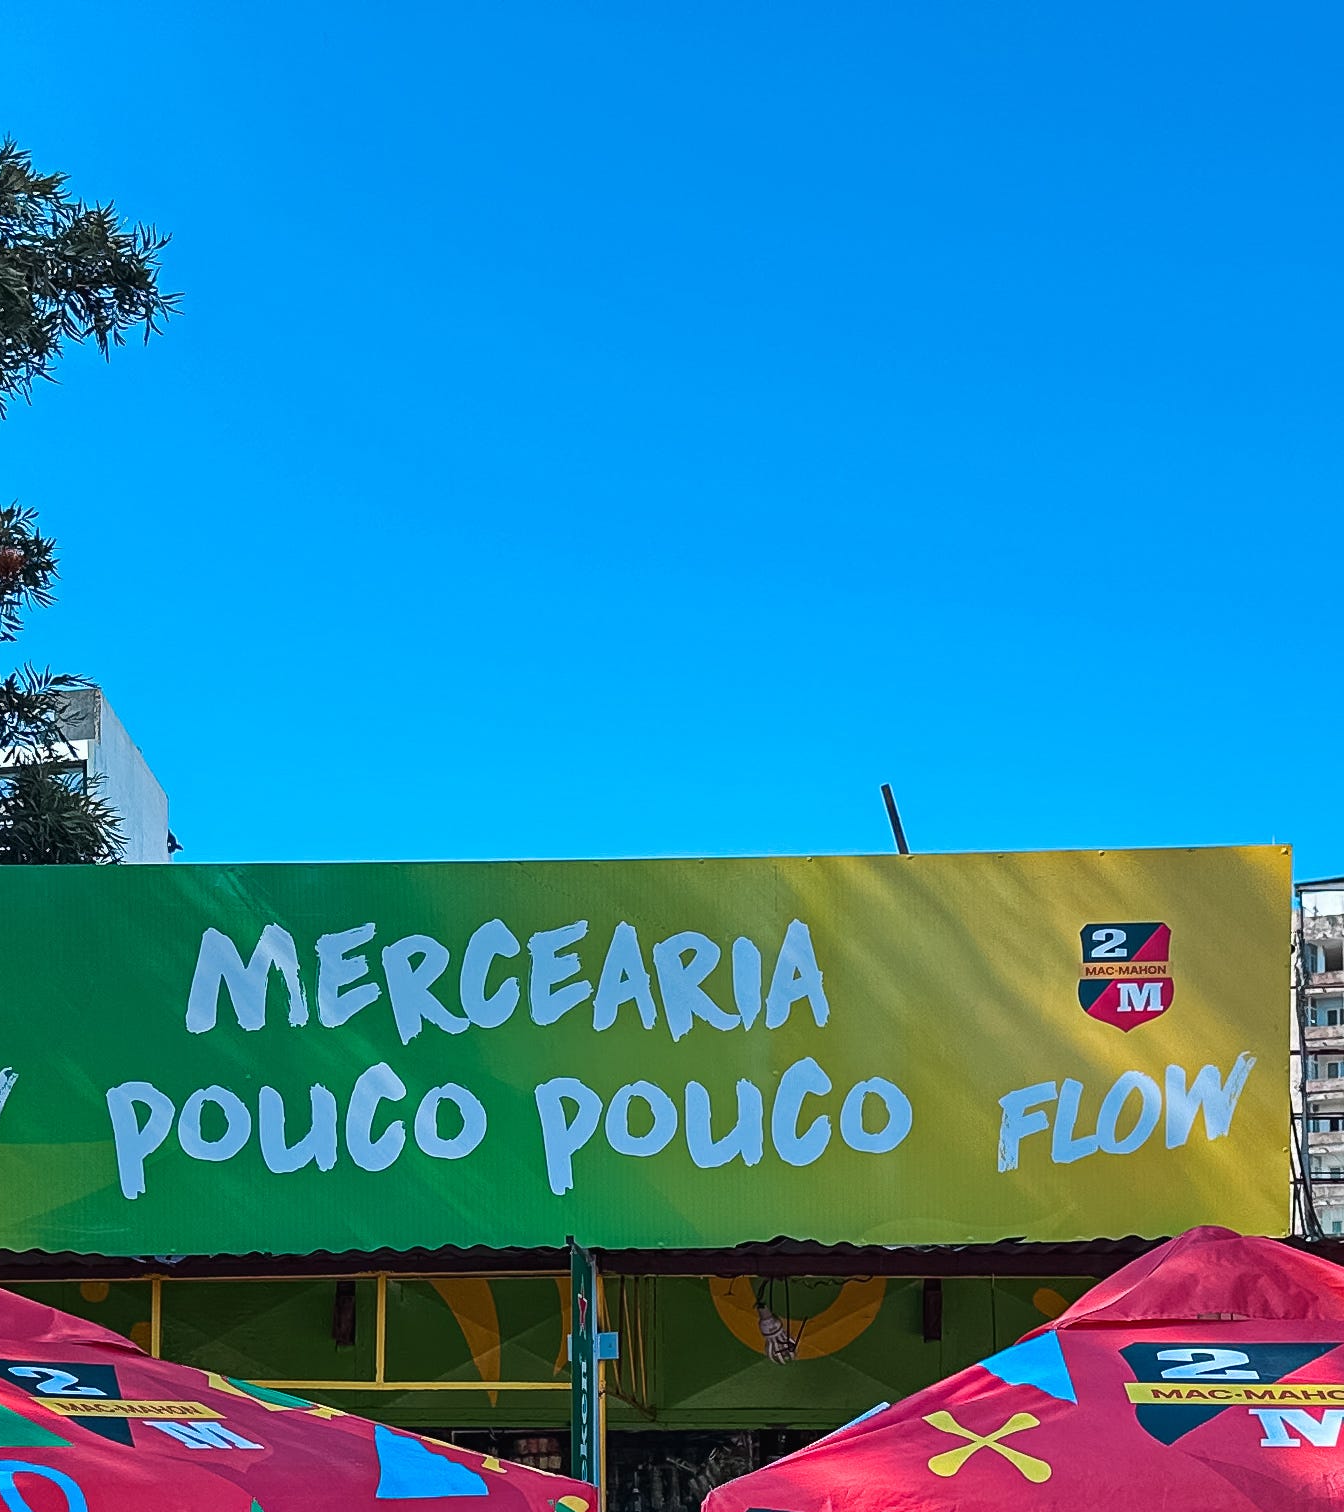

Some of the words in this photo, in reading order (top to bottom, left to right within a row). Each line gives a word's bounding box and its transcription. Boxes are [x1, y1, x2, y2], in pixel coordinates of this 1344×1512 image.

[1091, 928, 1129, 958] 2
[186, 919, 830, 1044] MERCEARIA
[1116, 982, 1164, 1013] M
[998, 1050, 1256, 1173] FLOW
[106, 1061, 488, 1200] POUCO
[534, 1056, 913, 1196] POUCO
[1157, 1348, 1259, 1380] 2
[7, 1366, 107, 1395] 2
[142, 1421, 265, 1450] M
